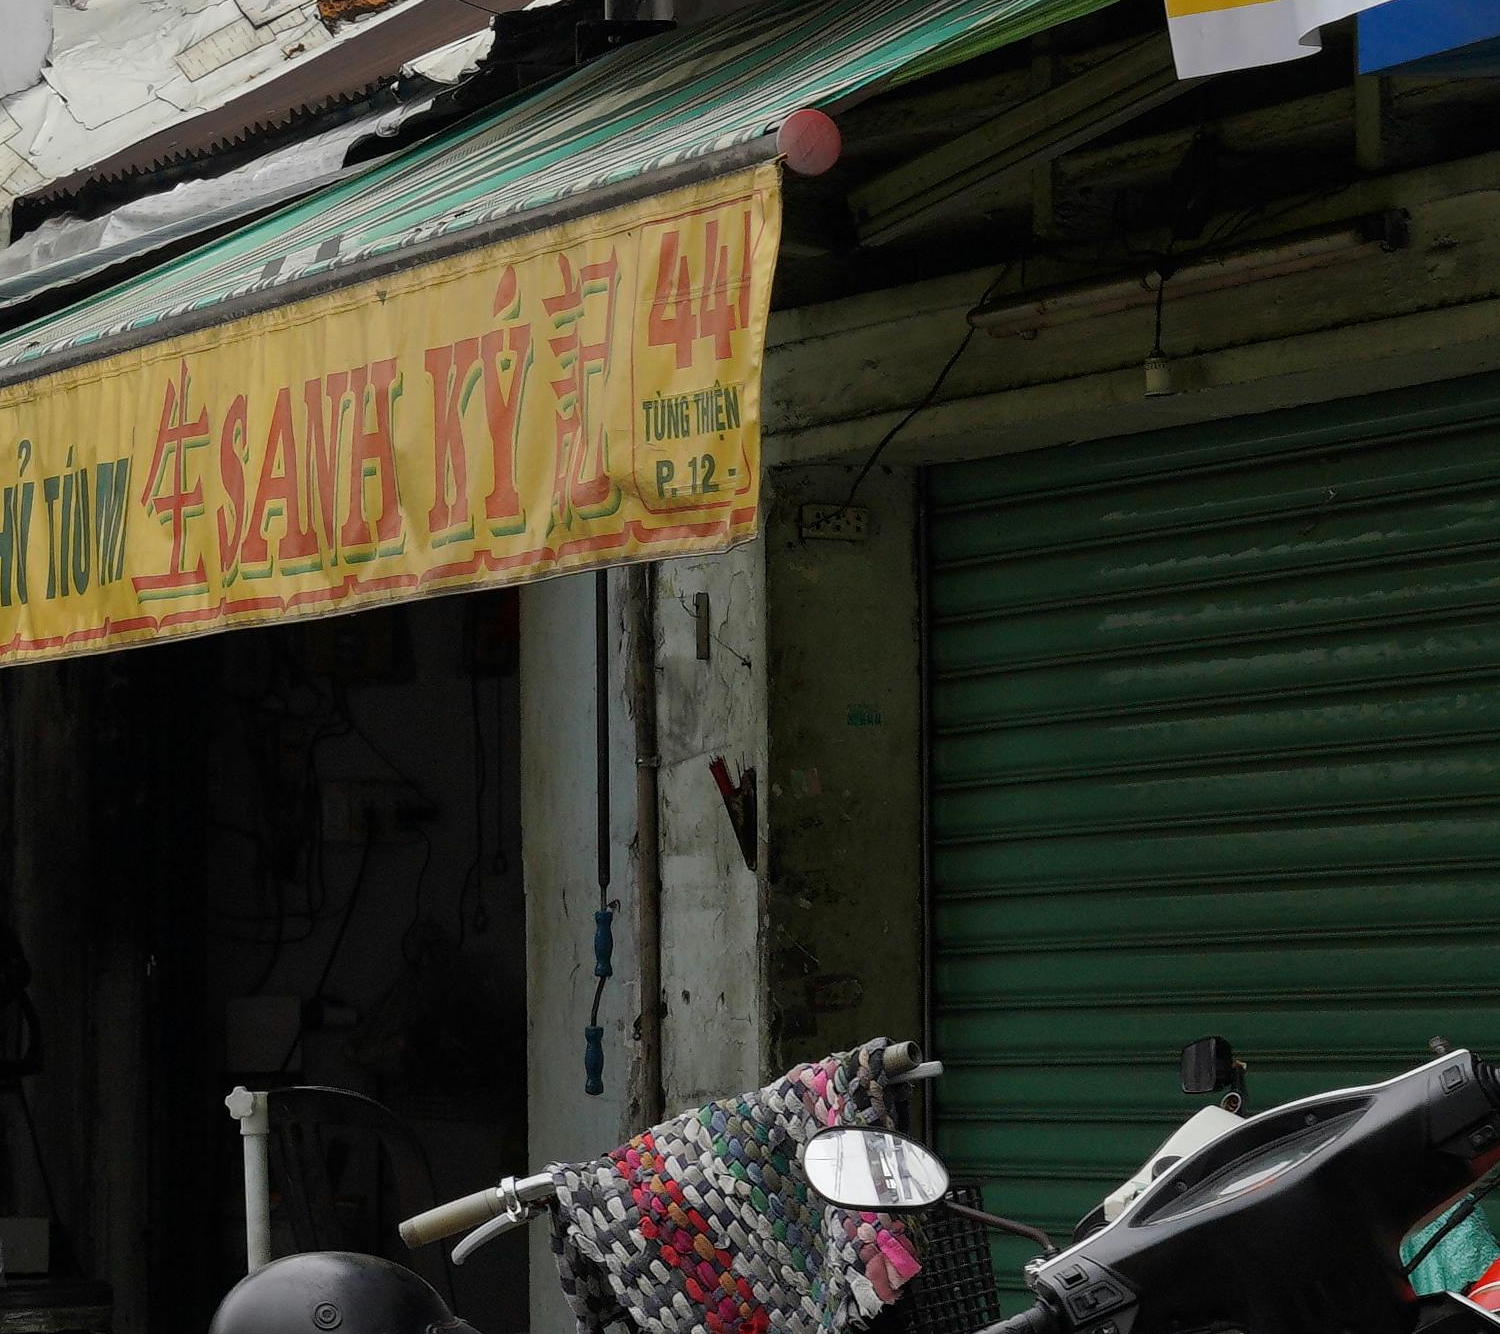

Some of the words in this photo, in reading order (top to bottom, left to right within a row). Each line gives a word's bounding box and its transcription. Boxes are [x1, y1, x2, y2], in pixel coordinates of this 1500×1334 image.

[216, 357, 403, 579] SANH
[424, 265, 534, 537] KÝ
[642, 389, 690, 443] TÙNG
[692, 380, 741, 441] THIỆN
[687, 454, 719, 495] 12
